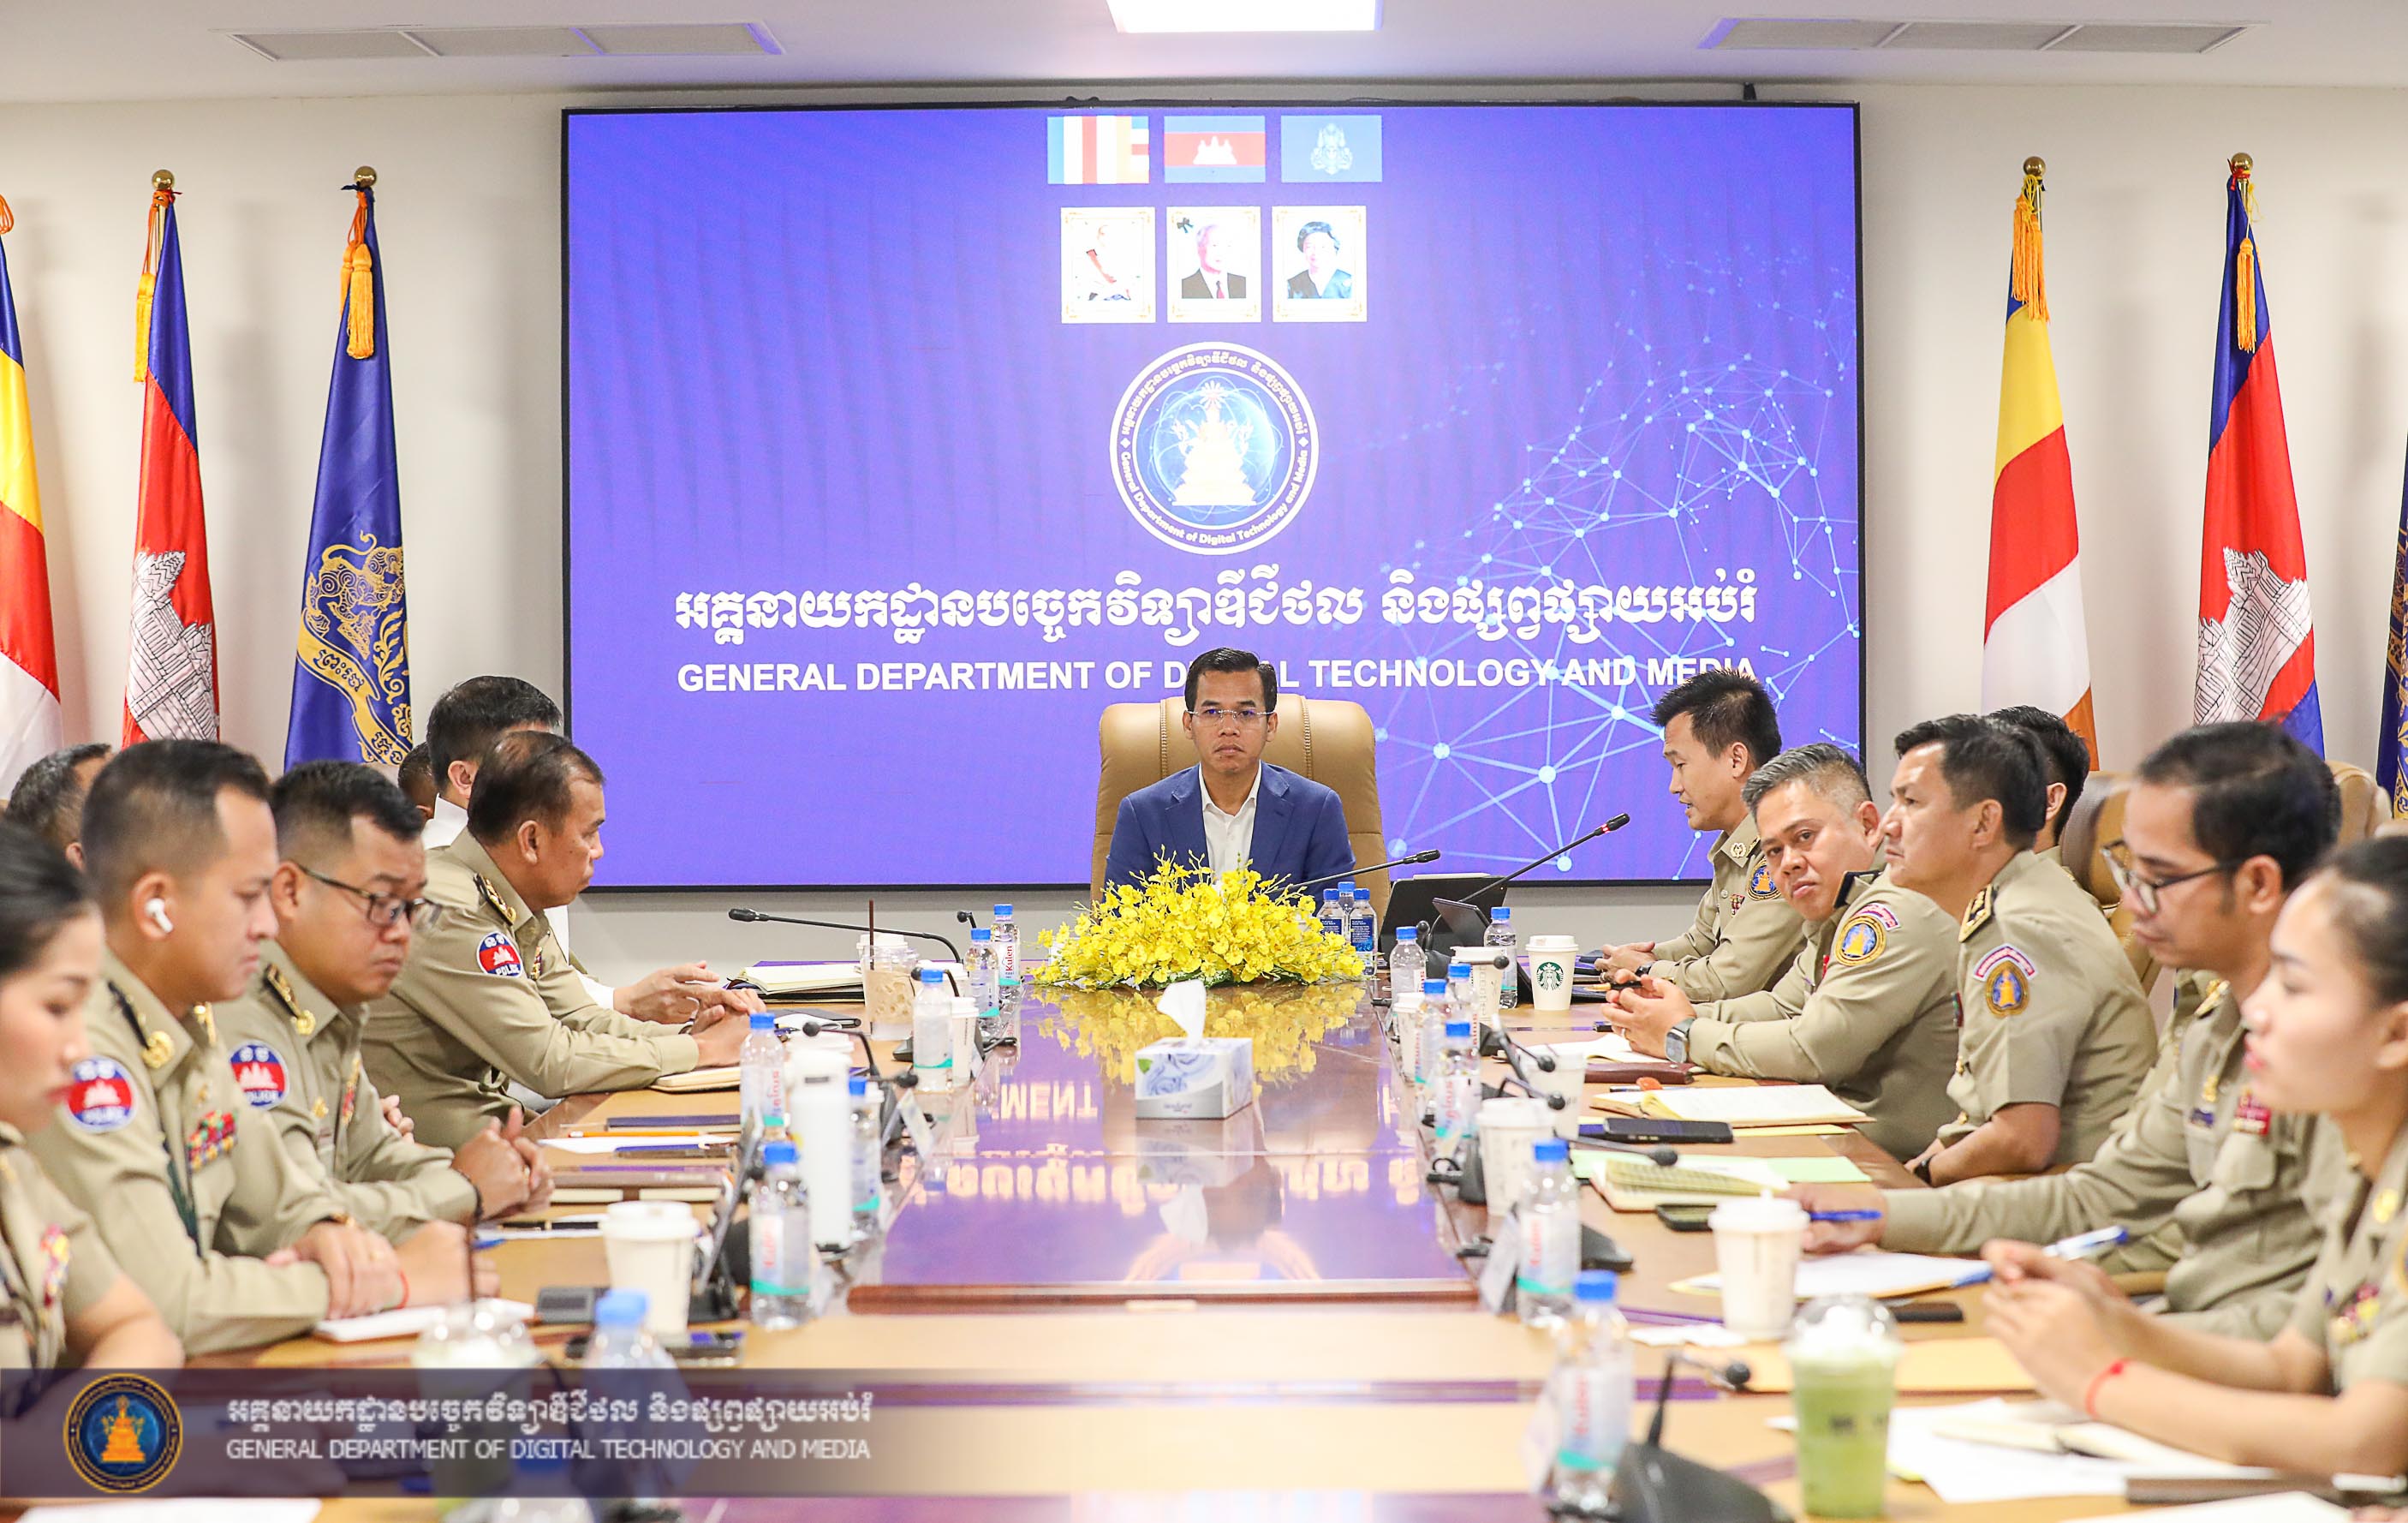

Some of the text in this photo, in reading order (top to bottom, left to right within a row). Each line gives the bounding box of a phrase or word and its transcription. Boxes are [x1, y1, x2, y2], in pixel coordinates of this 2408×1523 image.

[1186, 530, 1199, 542] of
[1198, 532, 1236, 546] Digital
[1236, 502, 1288, 541] Technology
[677, 663, 847, 692] GENERAL
[856, 660, 1095, 691] DEPARTMENT
[1105, 660, 1153, 689] OF
[1308, 659, 1553, 688] TECHNOLOGY
[1557, 658, 1636, 687] AND
[1004, 946, 1013, 971] Kulen
